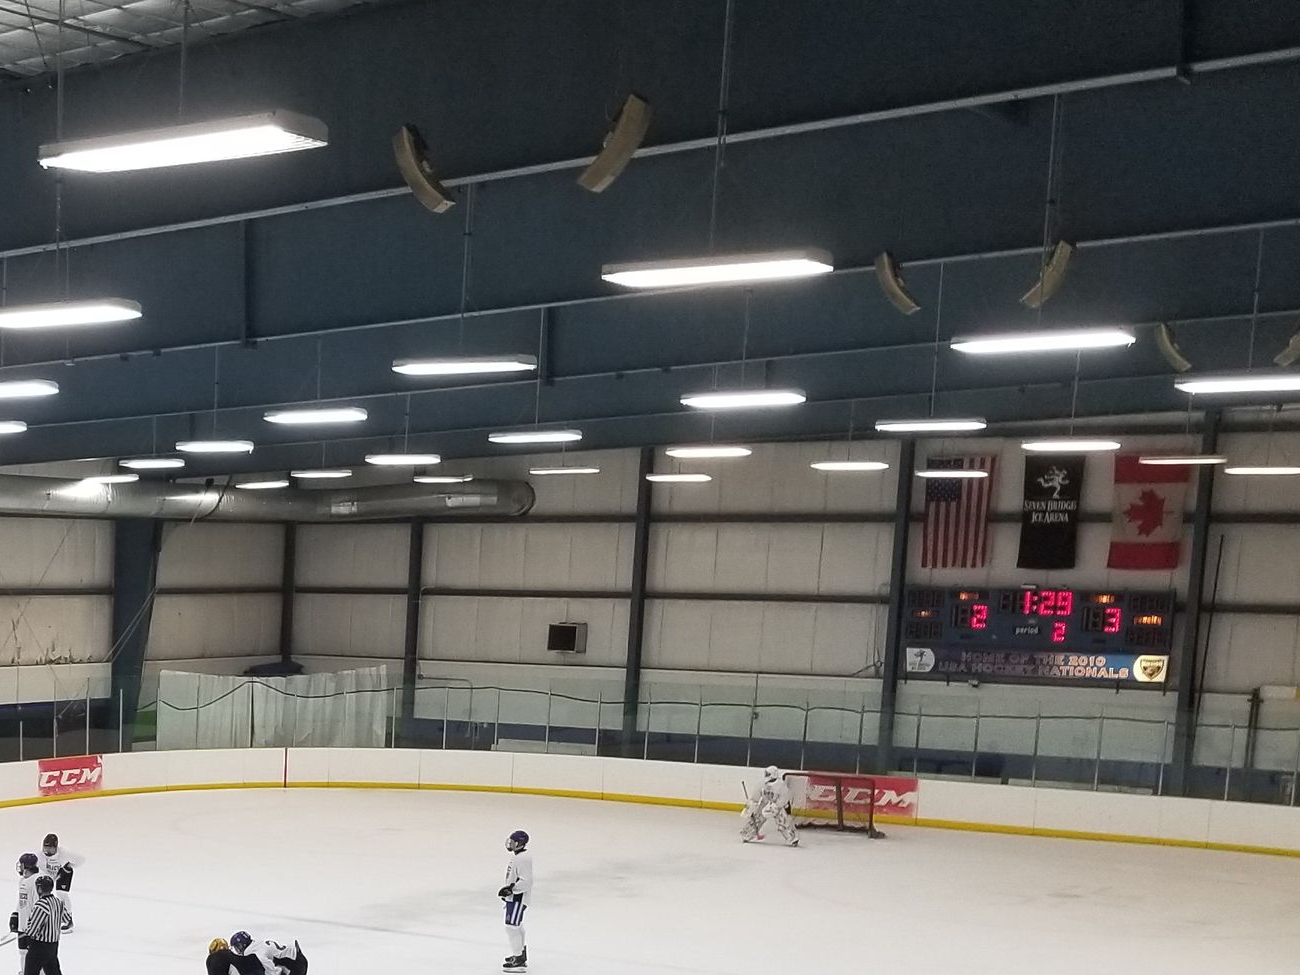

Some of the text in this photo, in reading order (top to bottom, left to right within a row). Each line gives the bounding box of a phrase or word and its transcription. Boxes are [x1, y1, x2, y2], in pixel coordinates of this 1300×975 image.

[1023, 590, 1073, 616] 1:29
[971, 604, 988, 630] 2
[1103, 608, 1121, 633] 3
[1015, 626, 1039, 636] period
[1053, 621, 1066, 642] 2
[1068, 655, 1106, 666] 2010
[1038, 665, 1129, 678] NATIONALS
[39, 767, 101, 787] CCM
